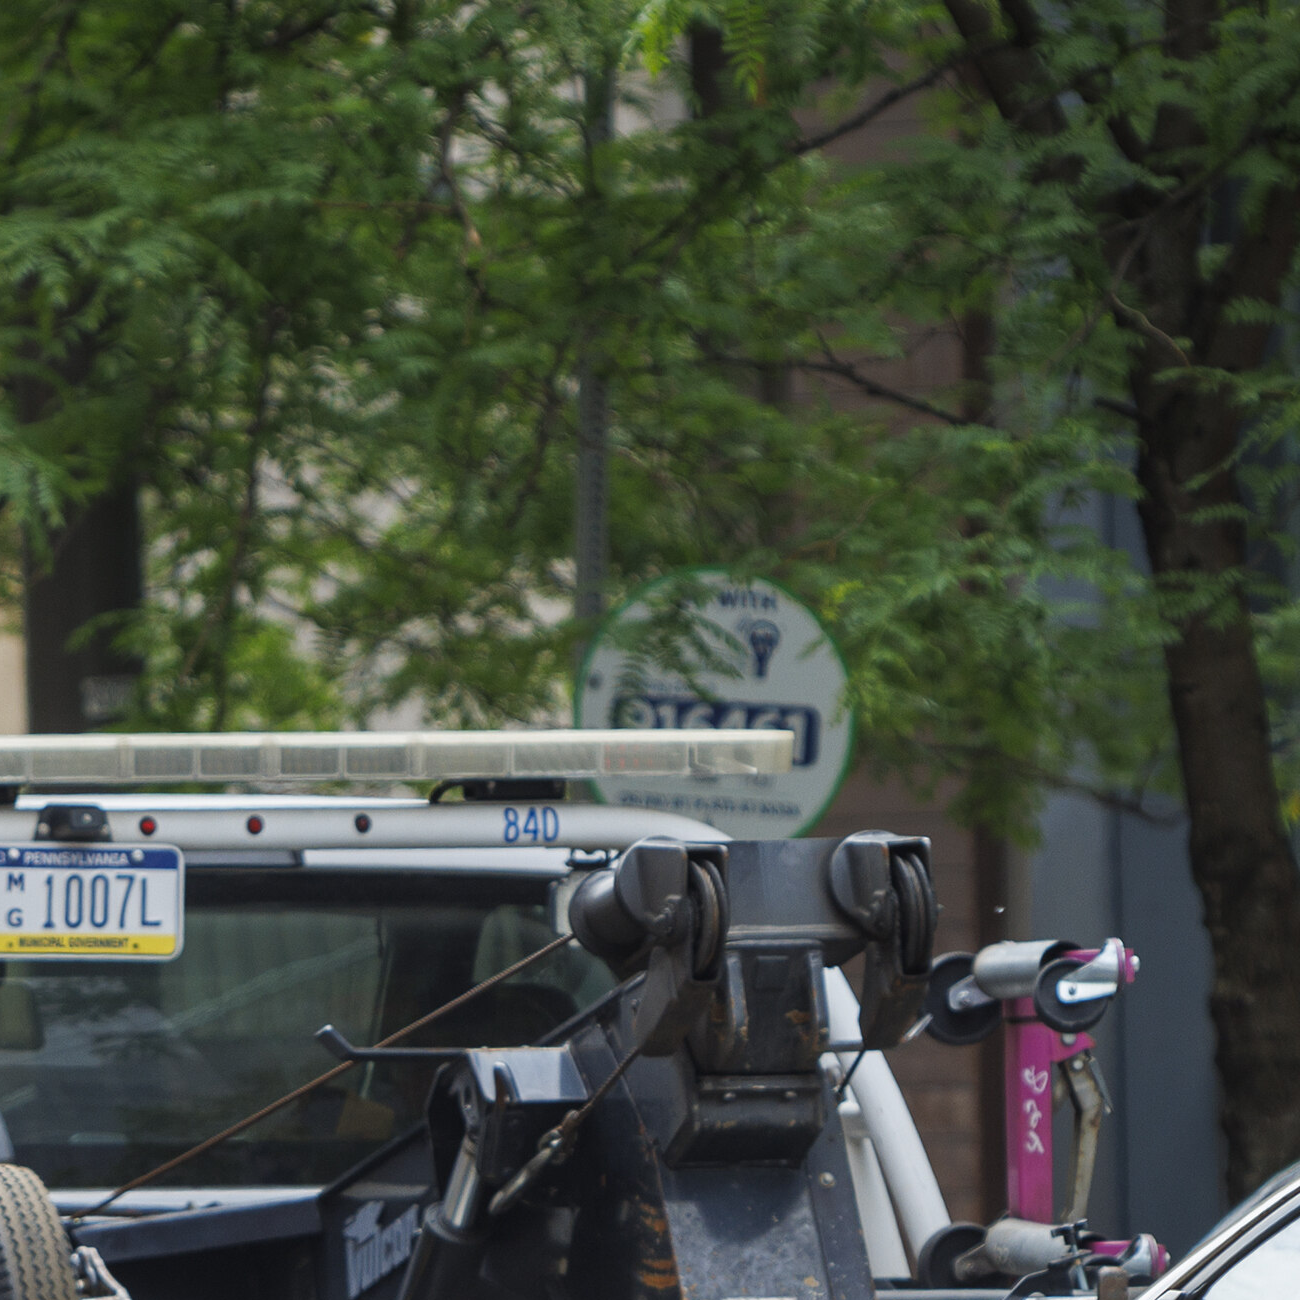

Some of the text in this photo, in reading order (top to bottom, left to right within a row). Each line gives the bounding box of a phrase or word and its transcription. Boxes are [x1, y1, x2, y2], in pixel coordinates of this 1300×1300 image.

[503, 806, 560, 843] 84D
[22, 851, 130, 866] PENNSYLVANIA
[42, 873, 163, 929] 1007L
[18, 937, 130, 949] MUNICIPAL GOVERNMENT
